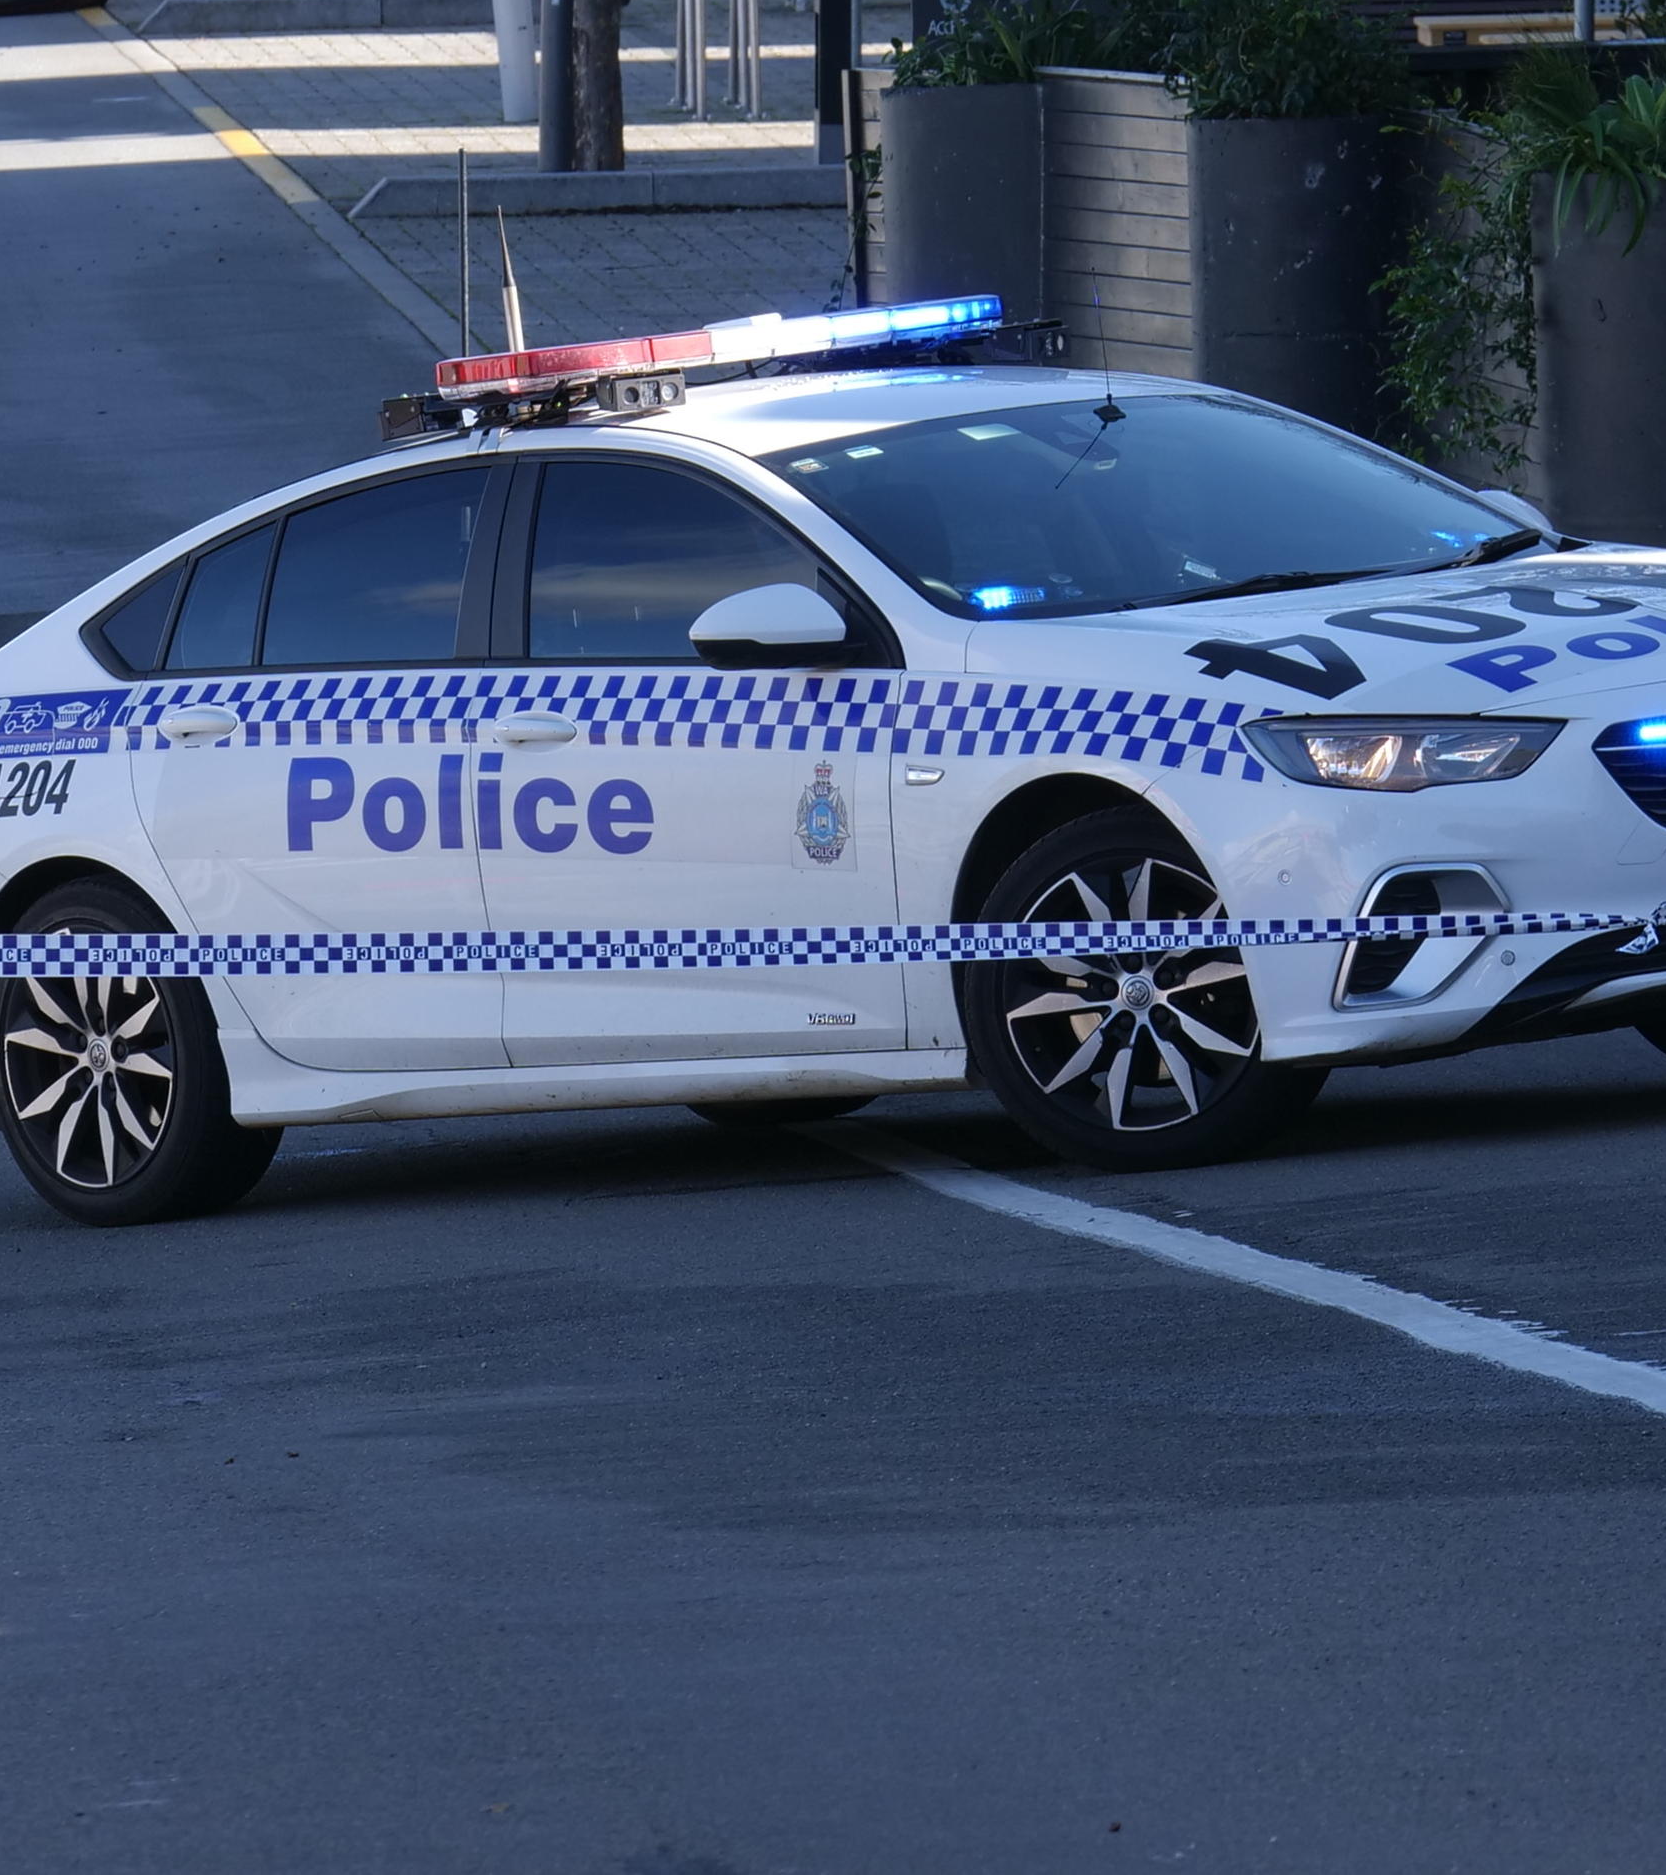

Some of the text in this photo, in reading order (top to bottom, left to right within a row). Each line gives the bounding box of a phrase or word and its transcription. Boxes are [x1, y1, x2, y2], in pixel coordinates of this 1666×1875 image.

[54, 737, 76, 750] dial
[287, 752, 655, 855] Police
[809, 847, 837, 858] POLICE
[710, 941, 793, 955] POLICE
[963, 935, 1047, 951] POLICE
[202, 947, 284, 962] POLICE
[456, 944, 537, 959] POLICE
